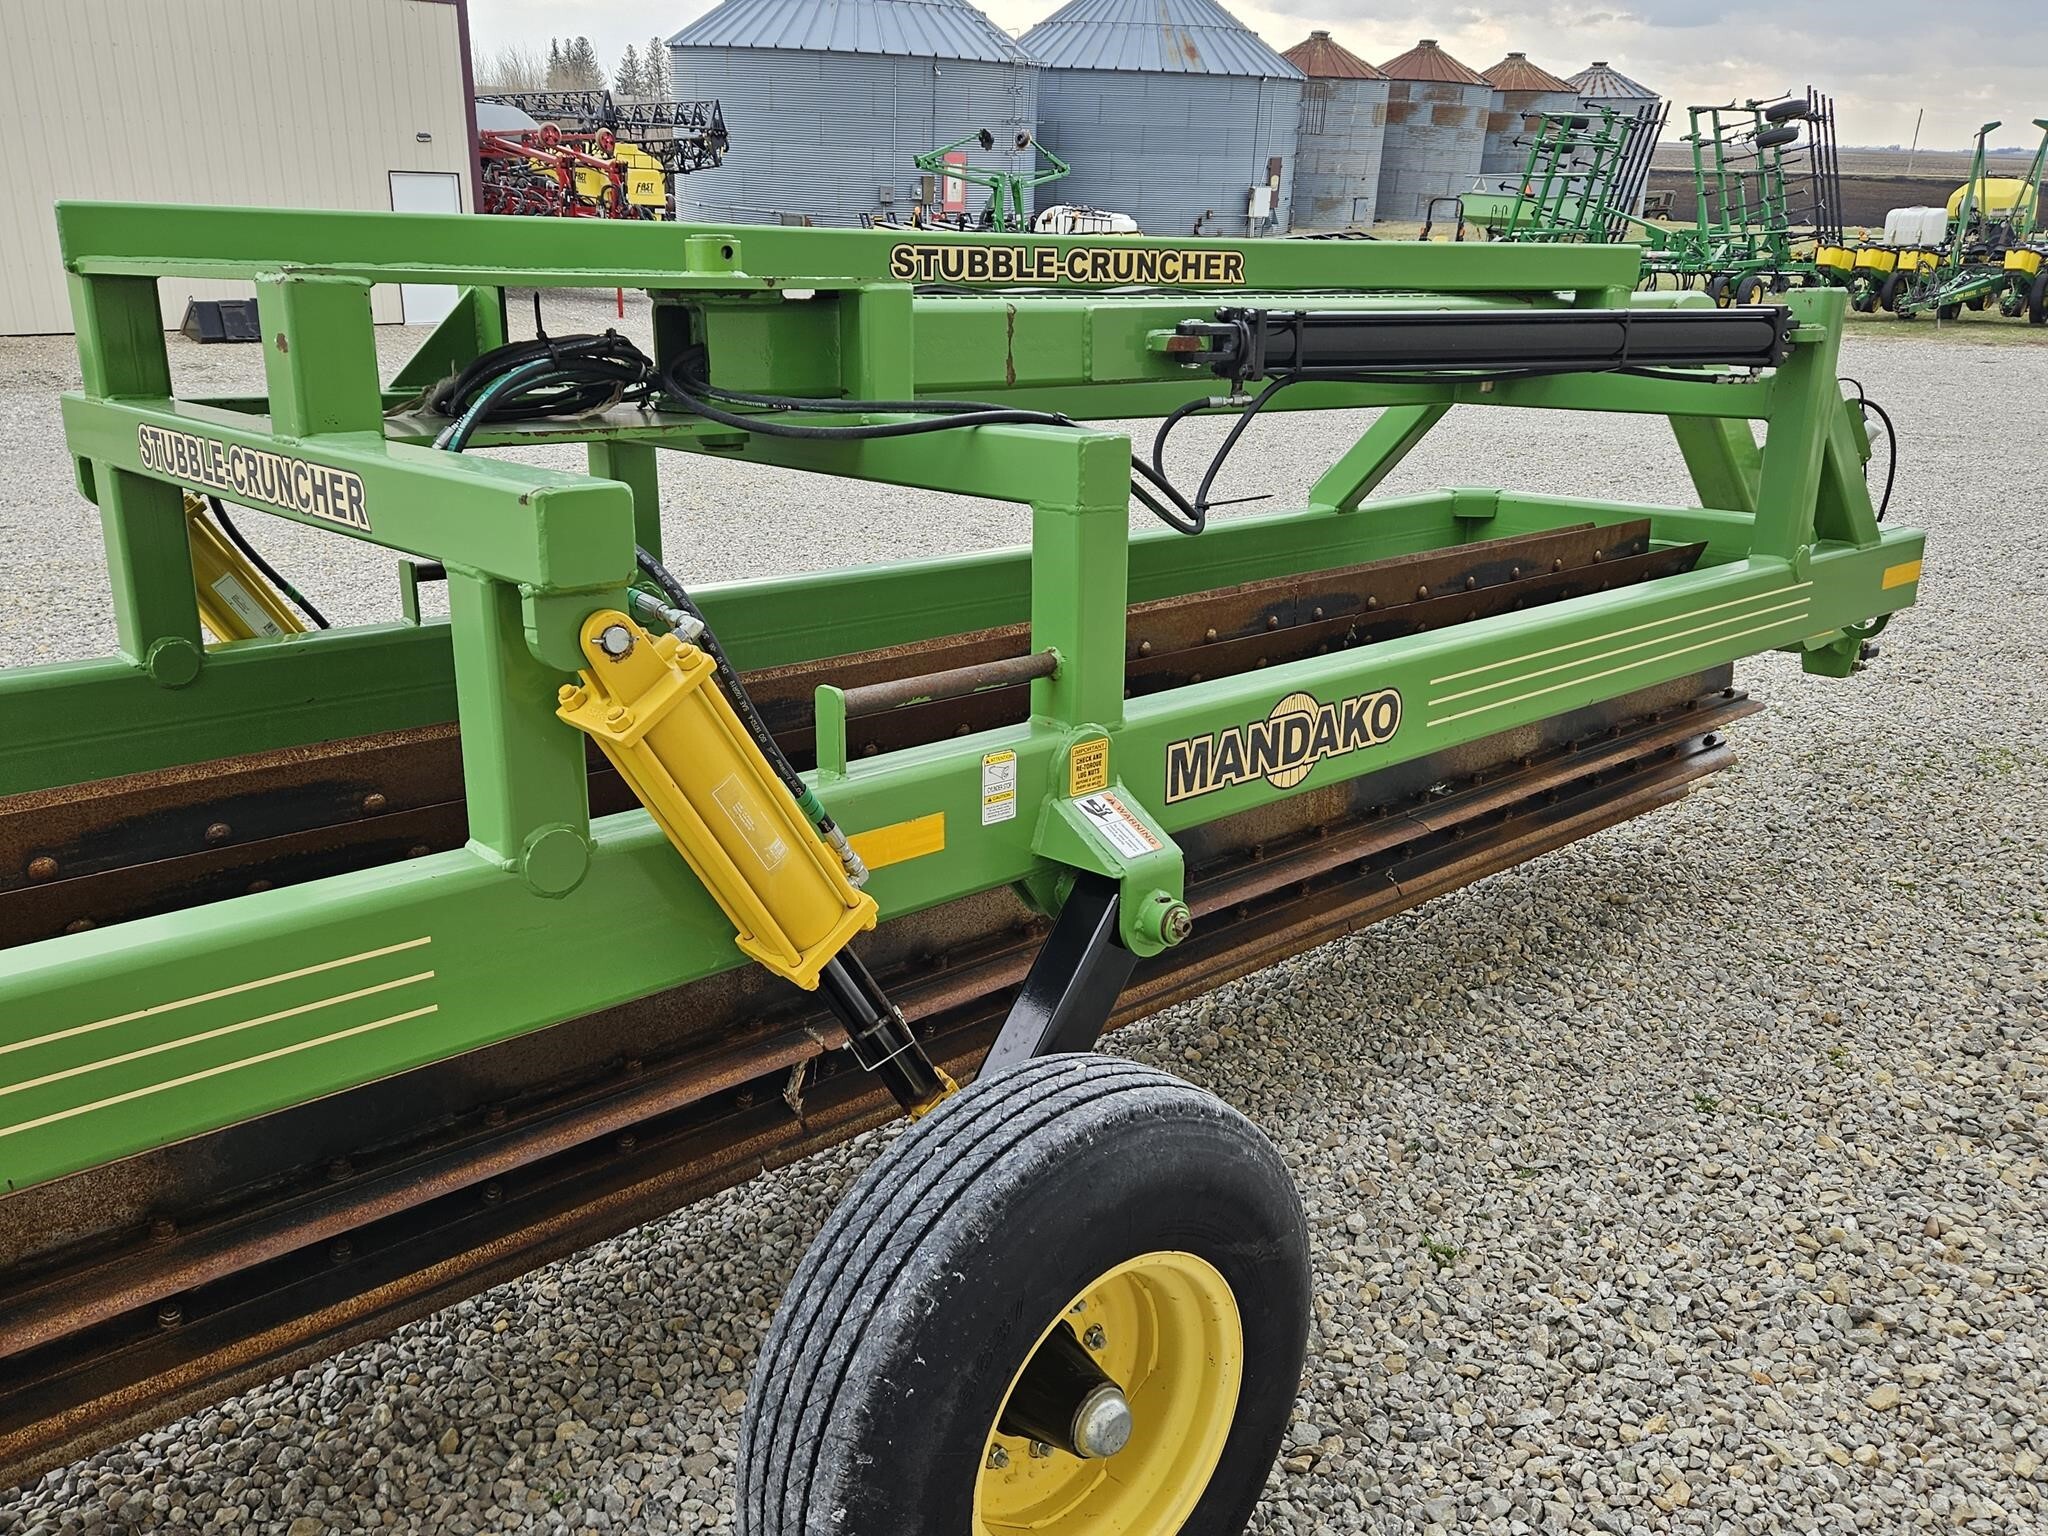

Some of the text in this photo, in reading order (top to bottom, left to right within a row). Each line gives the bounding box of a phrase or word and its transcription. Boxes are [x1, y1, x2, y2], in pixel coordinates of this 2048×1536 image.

[636, 183, 654, 193] FAST
[890, 243, 1246, 285] STUBBLE-CRUNCHER
[137, 422, 373, 535] STUBBLE-CRUNCHER
[738, 700, 750, 711] SAE
[1074, 742, 1105, 755] IMPORTANT
[1165, 687, 1403, 806] MANDAKO
[1076, 752, 1103, 765] CHECK AND
[1076, 759, 1102, 771] RE-TORQUE
[1077, 767, 1100, 779] LUG NUTS
[1116, 805, 1158, 846] WARNING
